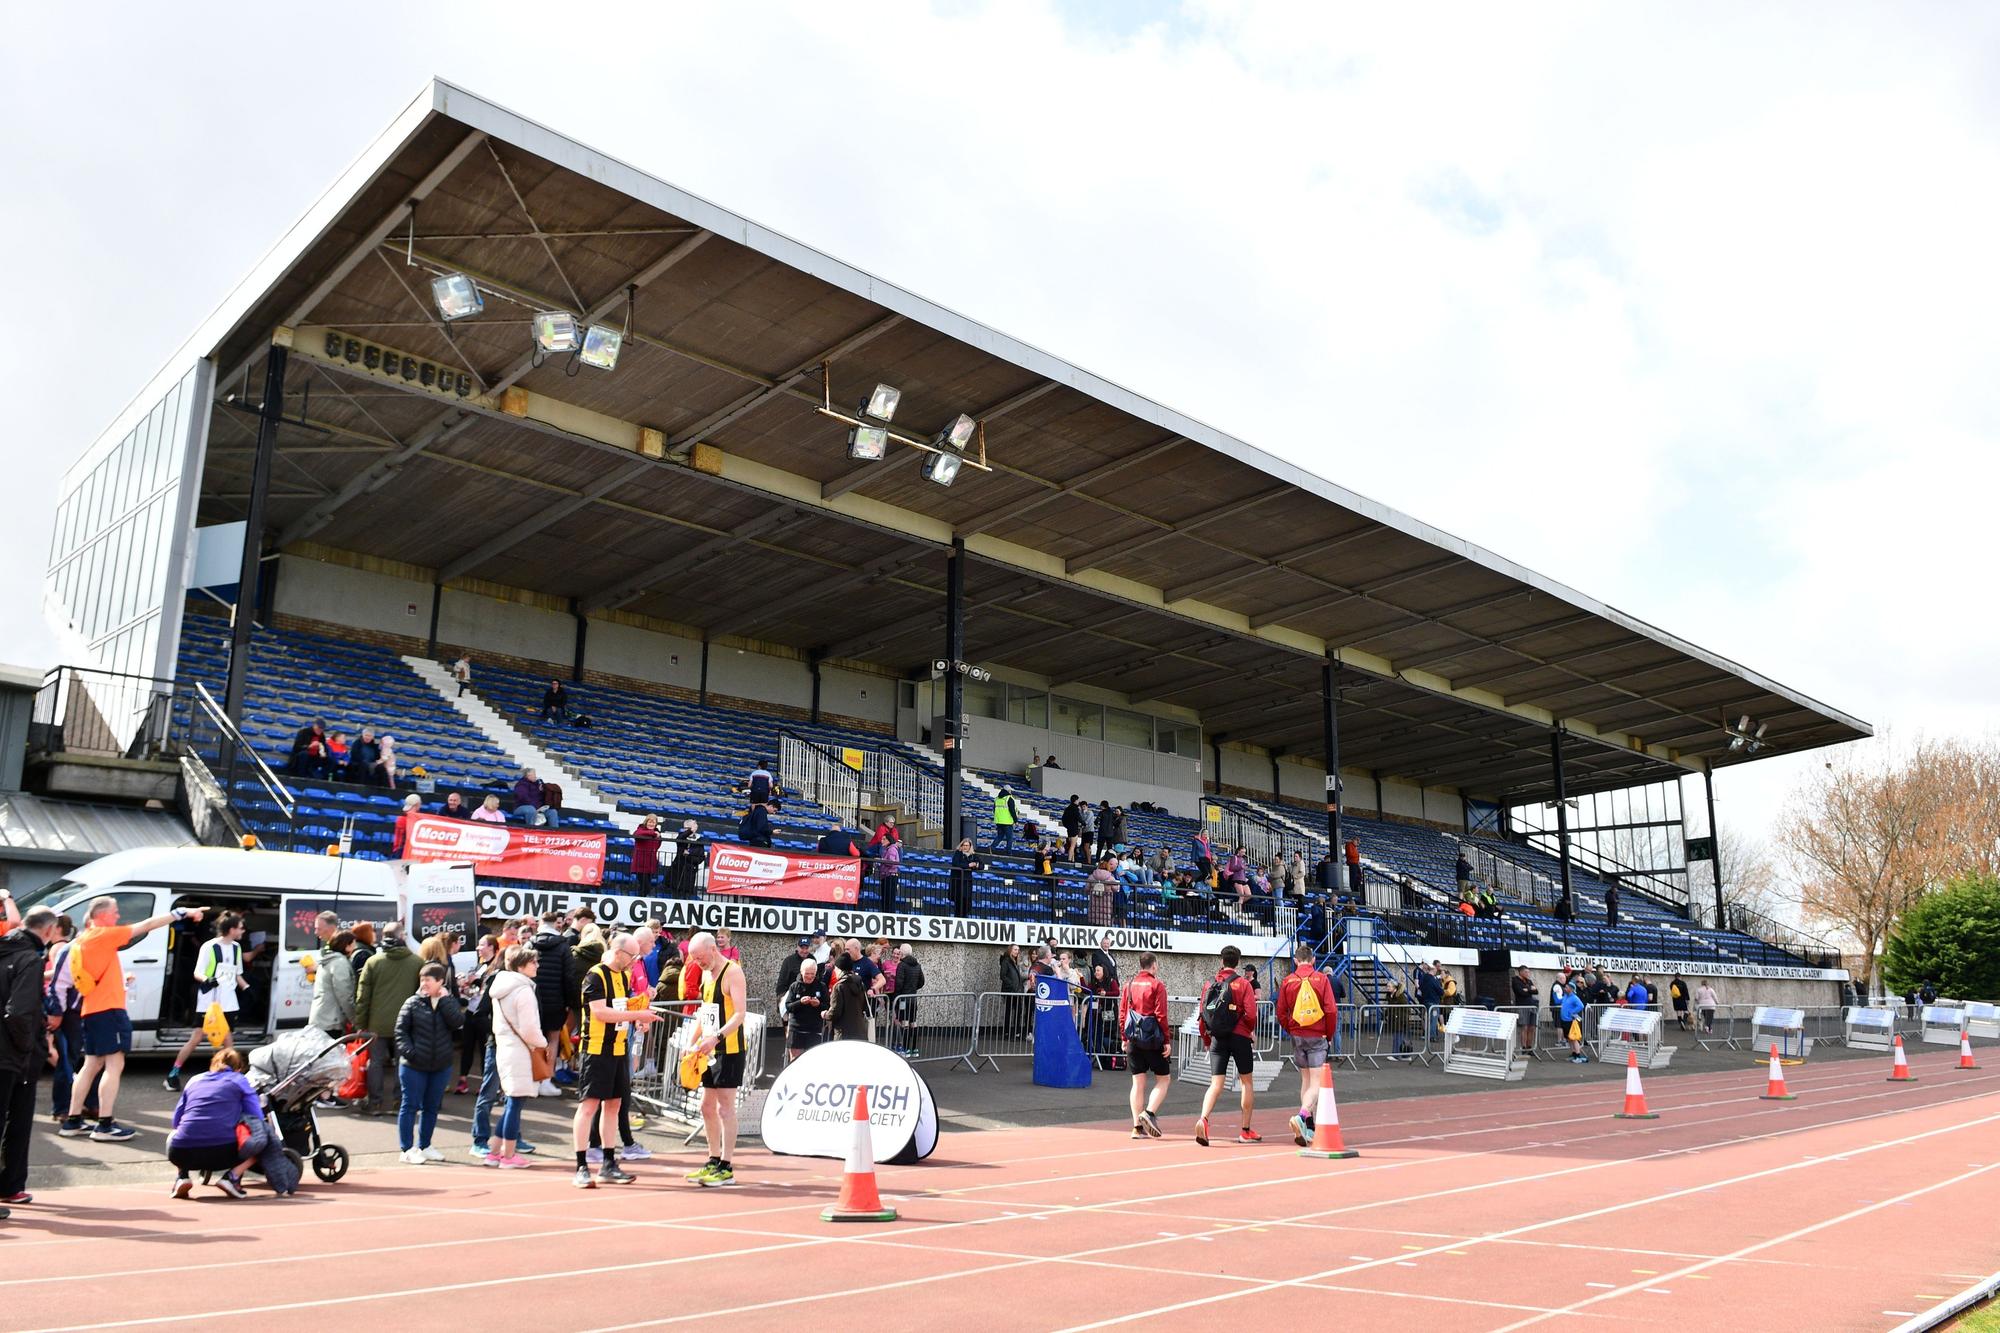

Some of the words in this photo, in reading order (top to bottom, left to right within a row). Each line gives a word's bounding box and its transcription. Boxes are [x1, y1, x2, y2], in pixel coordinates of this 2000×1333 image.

[418, 826, 459, 842] Moore
[719, 855, 750, 869] Moore
[754, 860, 782, 868] Equipment
[427, 884, 465, 894] Results
[421, 921, 466, 937] perfect
[580, 896, 619, 922] TO
[628, 899, 829, 932] GRANGEMOUTH
[836, 912, 922, 938] SPORTS
[928, 918, 1016, 942] STADIUM
[1026, 925, 1099, 946] FALKIRK
[1105, 929, 1173, 950] COUNCIL
[1558, 956, 1596, 968] WELCOME
[1610, 959, 1660, 972] GRANGEMOUTH
[1684, 963, 1709, 974] STADIUM
[1711, 964, 1723, 974] AND
[1723, 965, 1734, 975] THE
[1735, 966, 1760, 976] NATIONAL
[797, 1108, 851, 1124] BUILDING
[869, 1112, 906, 1127] CIETY
